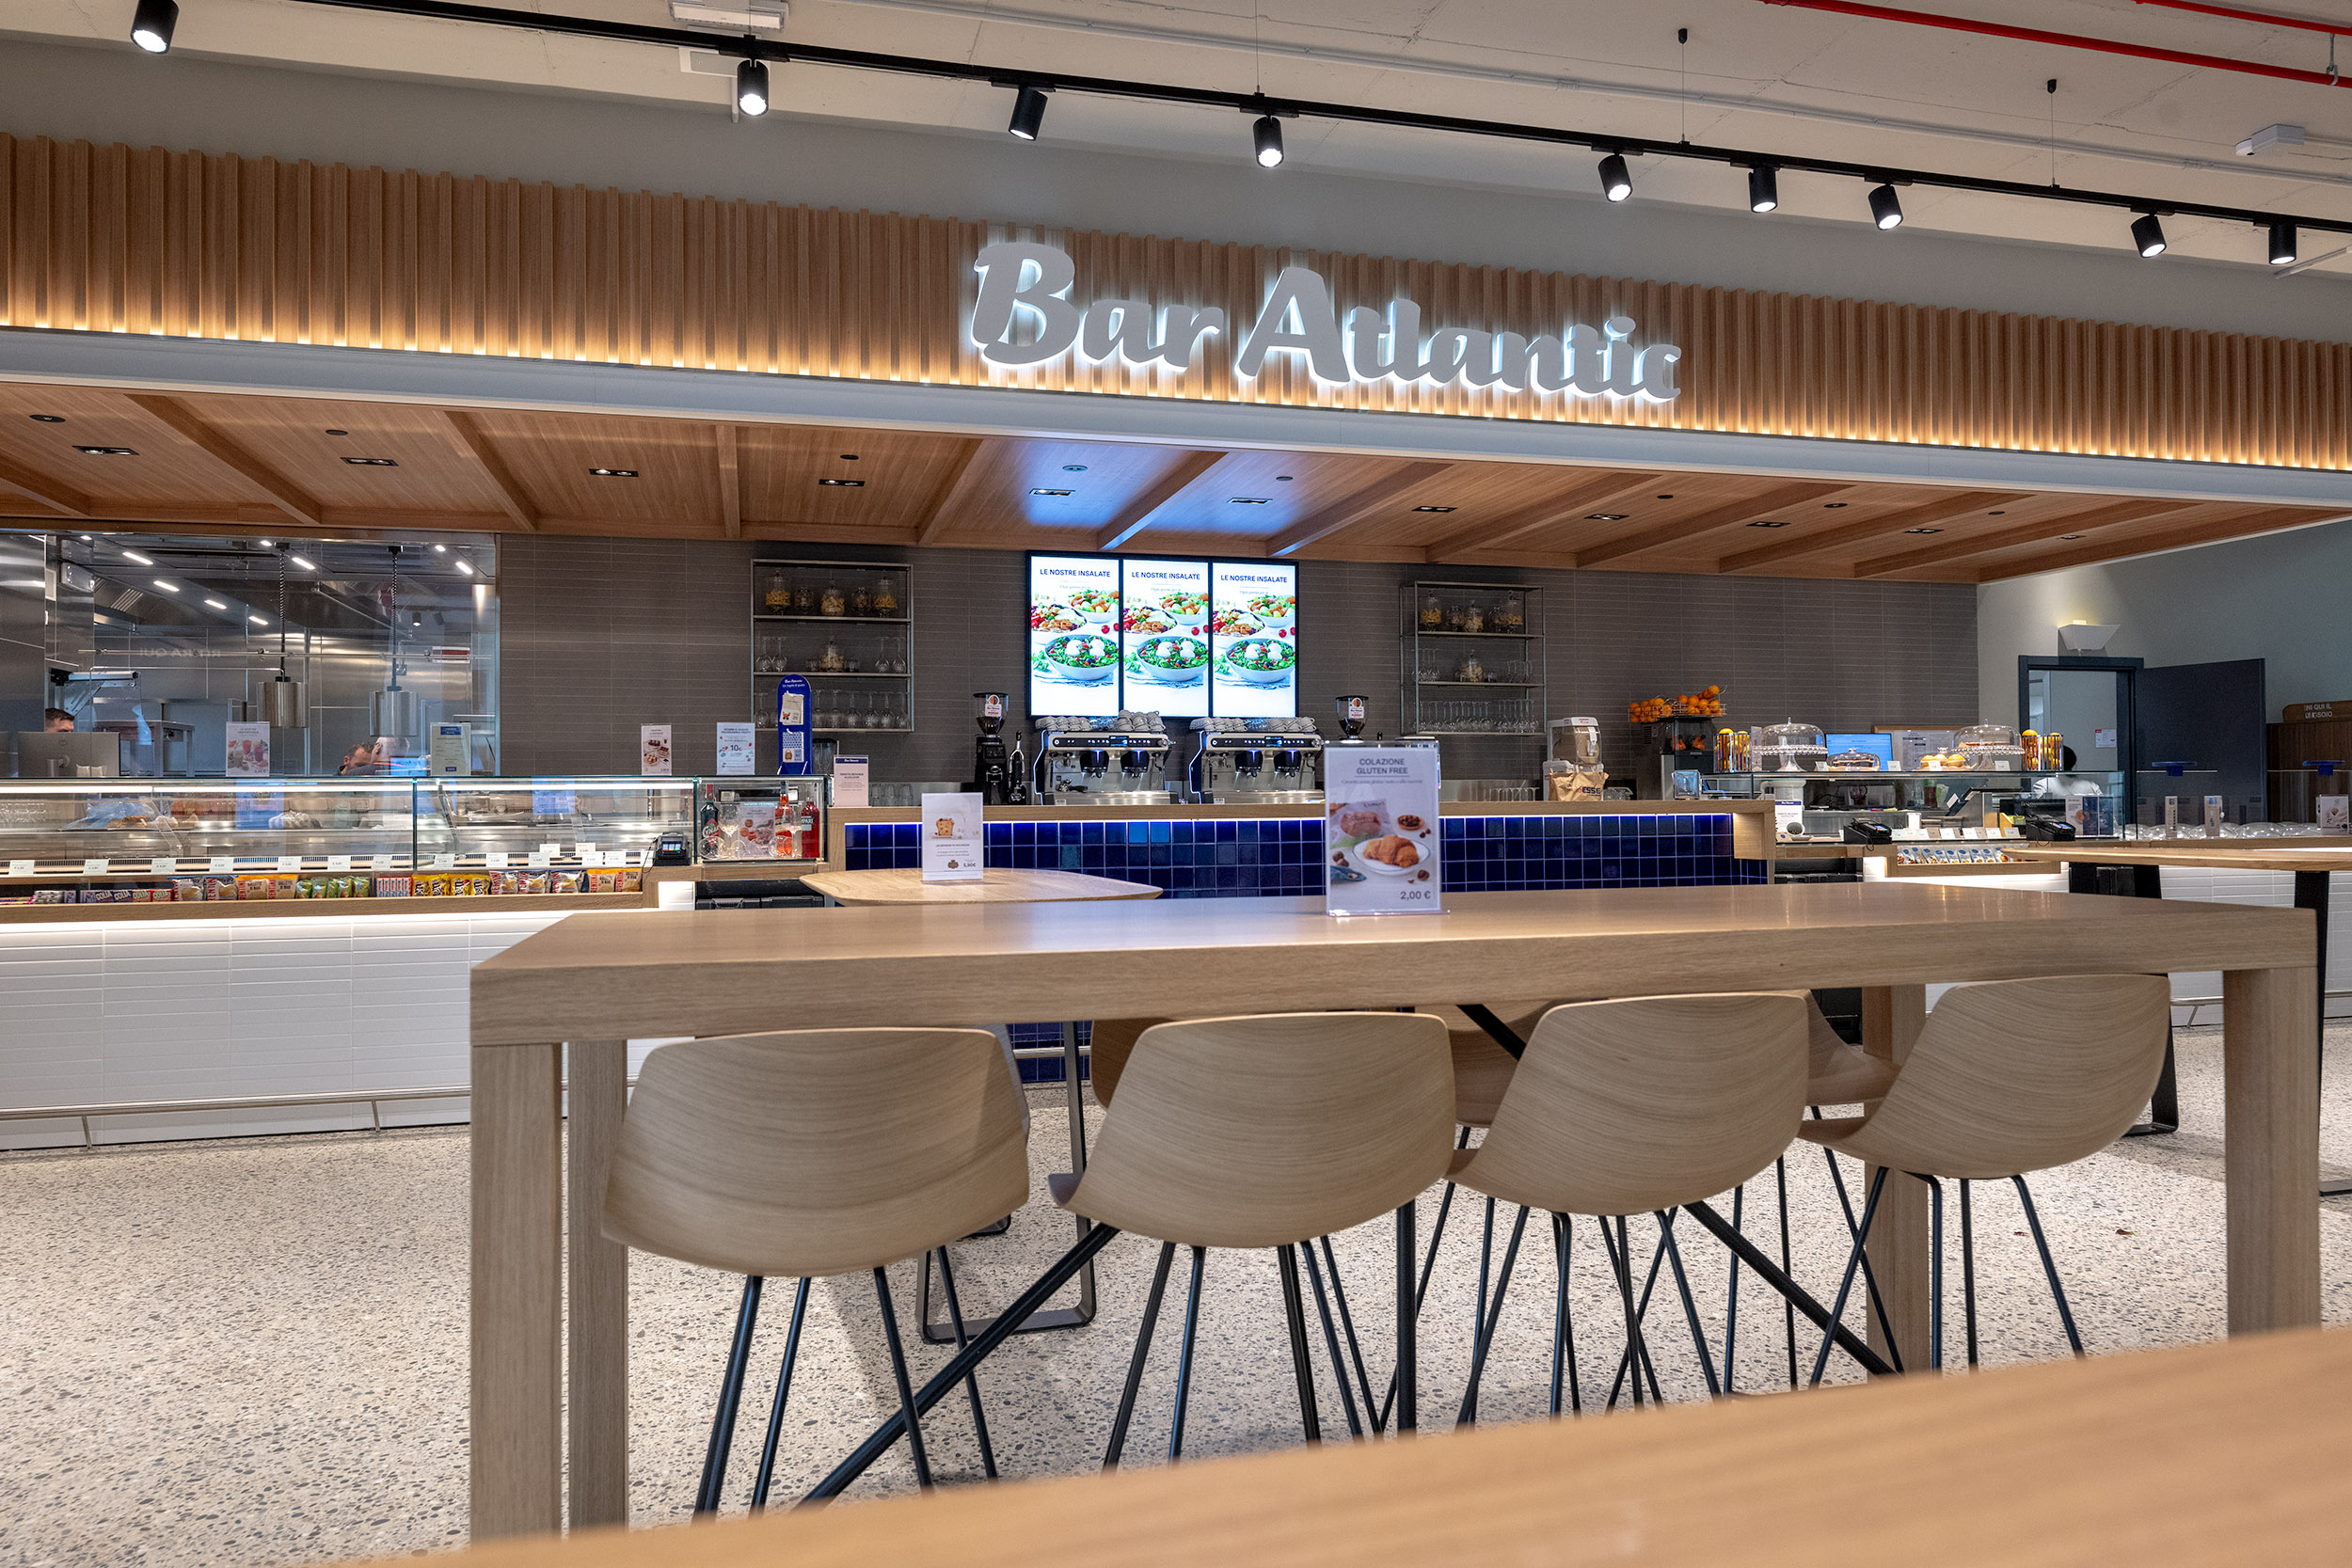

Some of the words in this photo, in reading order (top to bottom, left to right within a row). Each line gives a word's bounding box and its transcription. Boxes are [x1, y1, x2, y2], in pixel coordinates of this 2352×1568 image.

[972, 242, 1223, 372] Bar
[1235, 267, 1682, 402] Atlantic
[1400, 891, 1422, 901] 2,00
[1423, 890, 1431, 899] €
